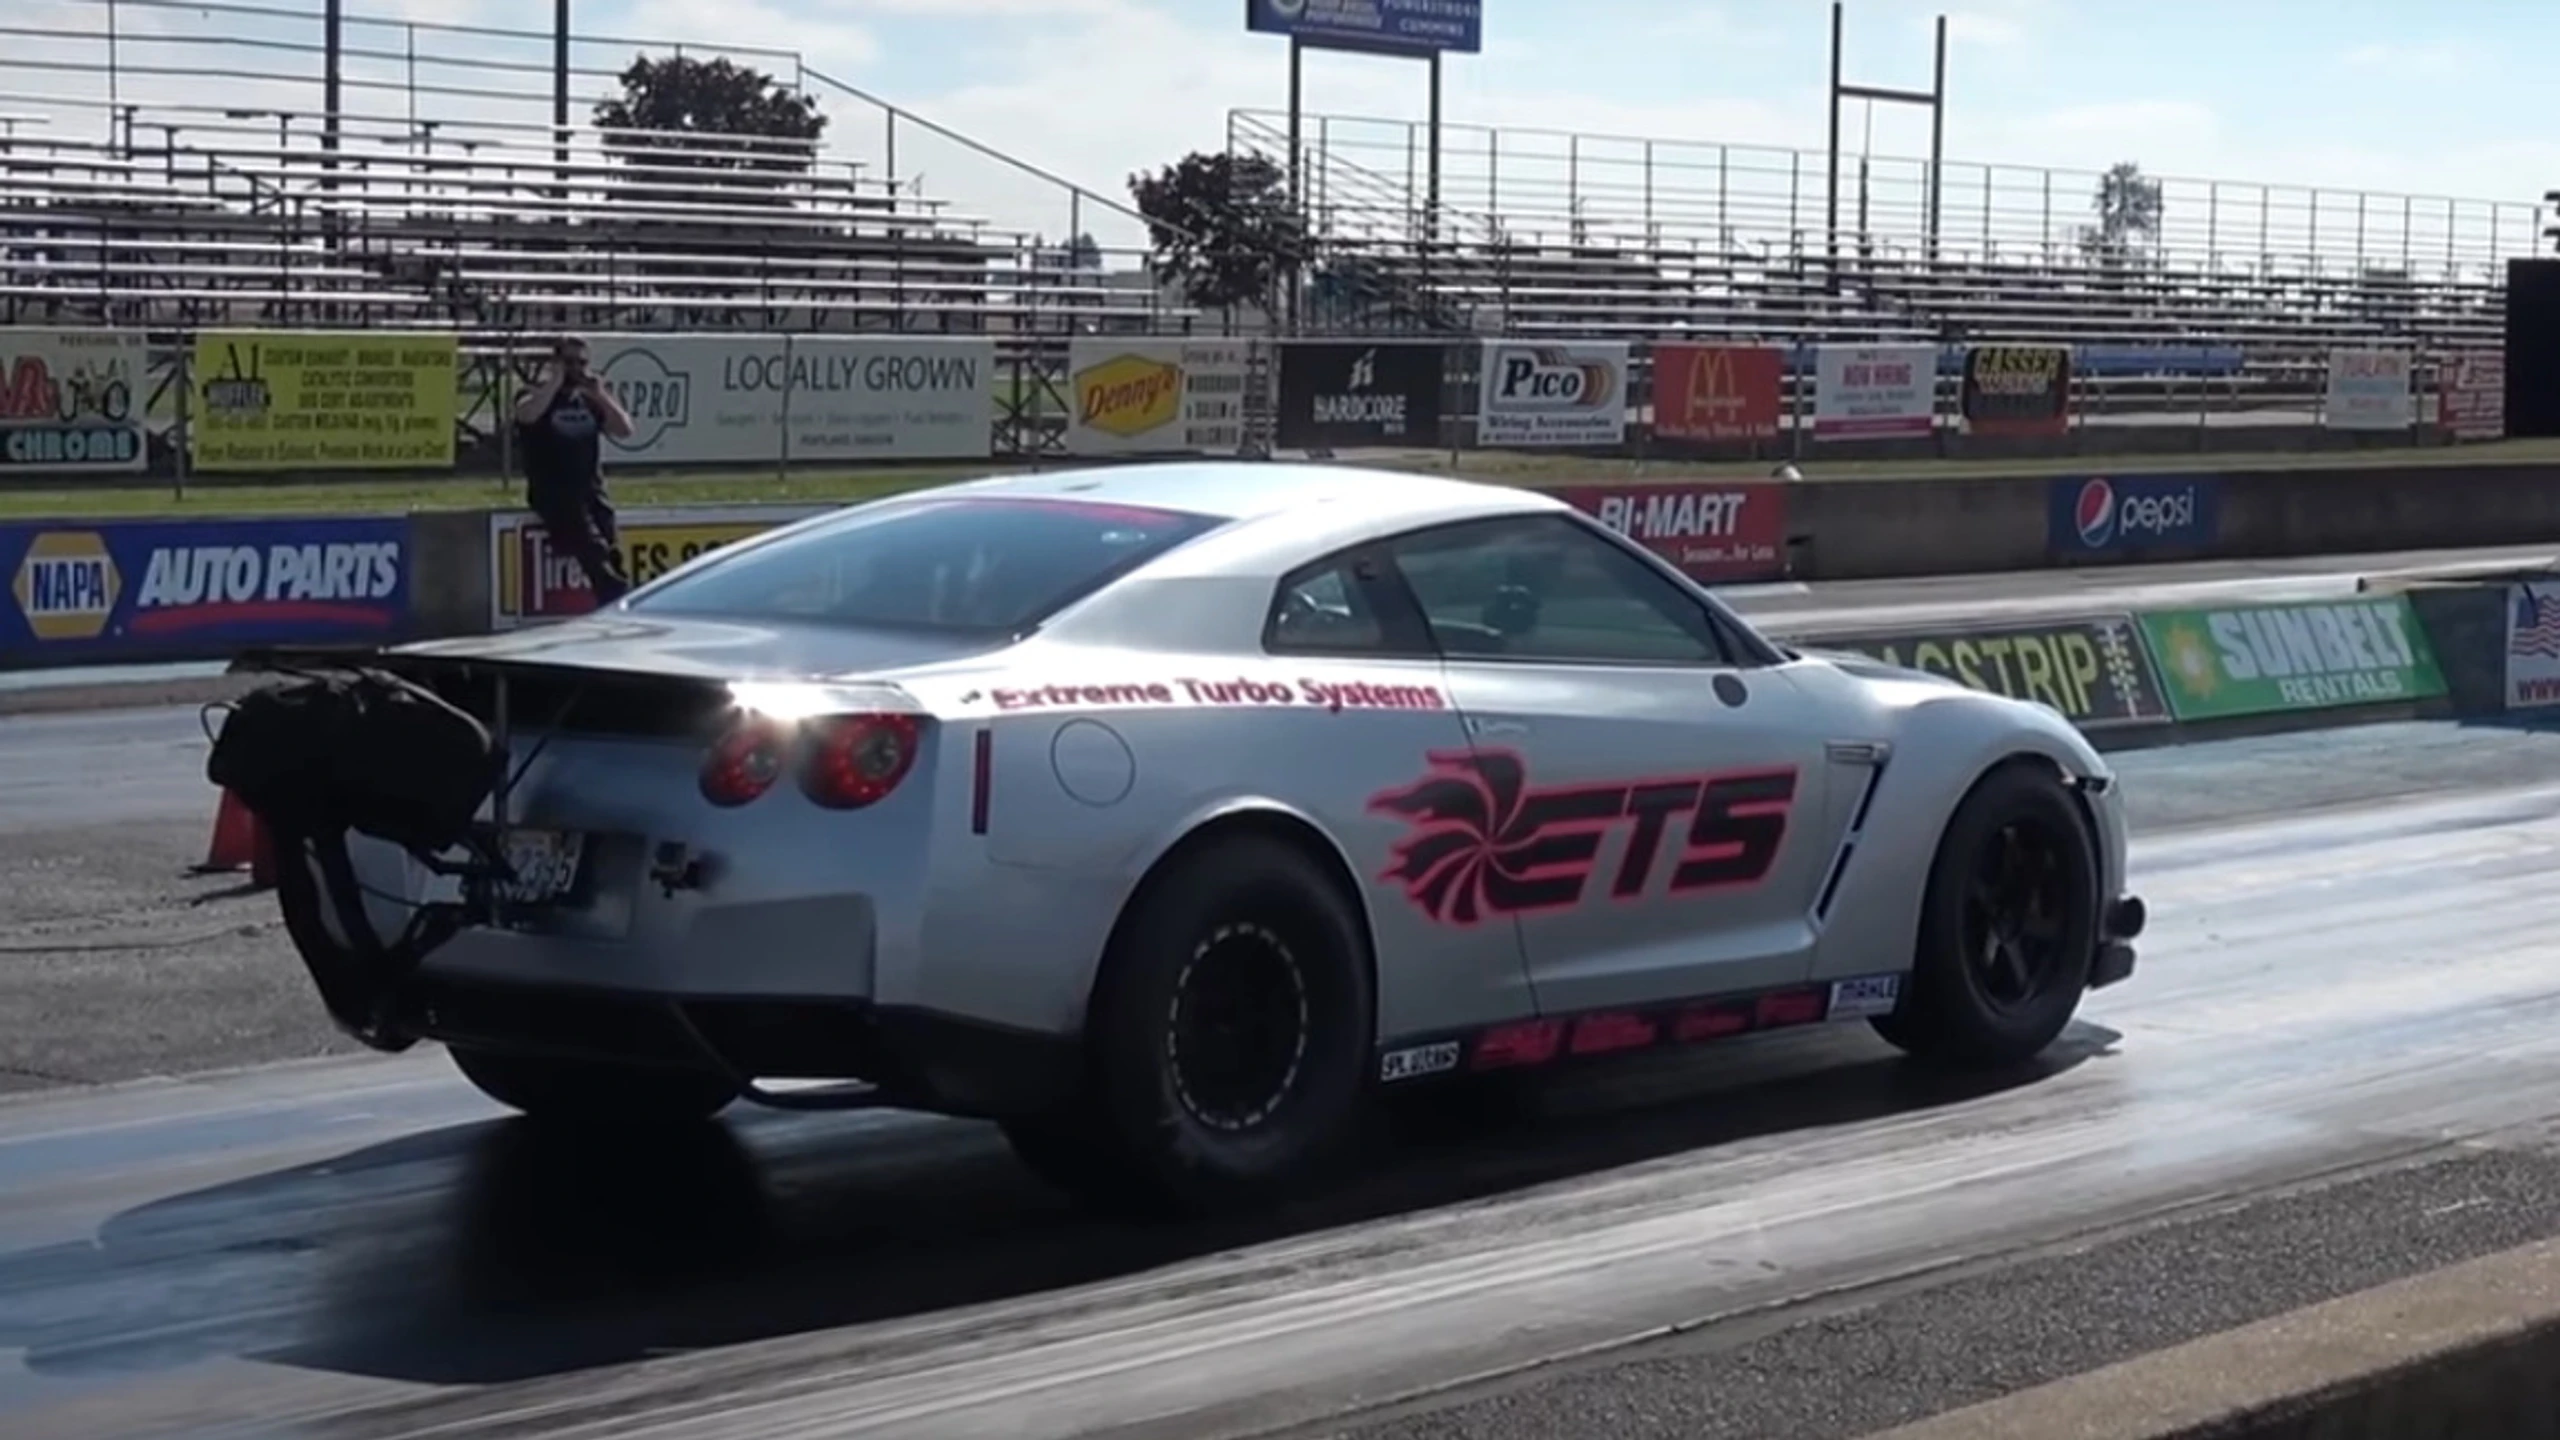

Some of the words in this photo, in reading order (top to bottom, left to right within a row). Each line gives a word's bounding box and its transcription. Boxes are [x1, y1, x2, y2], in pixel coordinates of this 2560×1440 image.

[724, 355, 857, 392] LOCALLY
[865, 356, 976, 392] GROWN
[1973, 349, 2061, 380] GASSER
[1079, 369, 1176, 424] Denny's
[1488, 415, 1533, 431] Wiring
[7, 430, 132, 461] CHROME
[2120, 485, 2194, 535] pepsi
[32, 560, 106, 611] NAPA
[138, 547, 265, 605] AUTO
[265, 541, 399, 600] PARTS
[2208, 604, 2414, 680] SUNBELT
[992, 681, 1170, 708] Extreme
[1175, 677, 1295, 703] Turbo
[1303, 679, 1445, 714] Systems
[1882, 634, 2098, 714] STRIP
[2277, 671, 2402, 702] RENTALS
[1490, 766, 1798, 912] ETS
